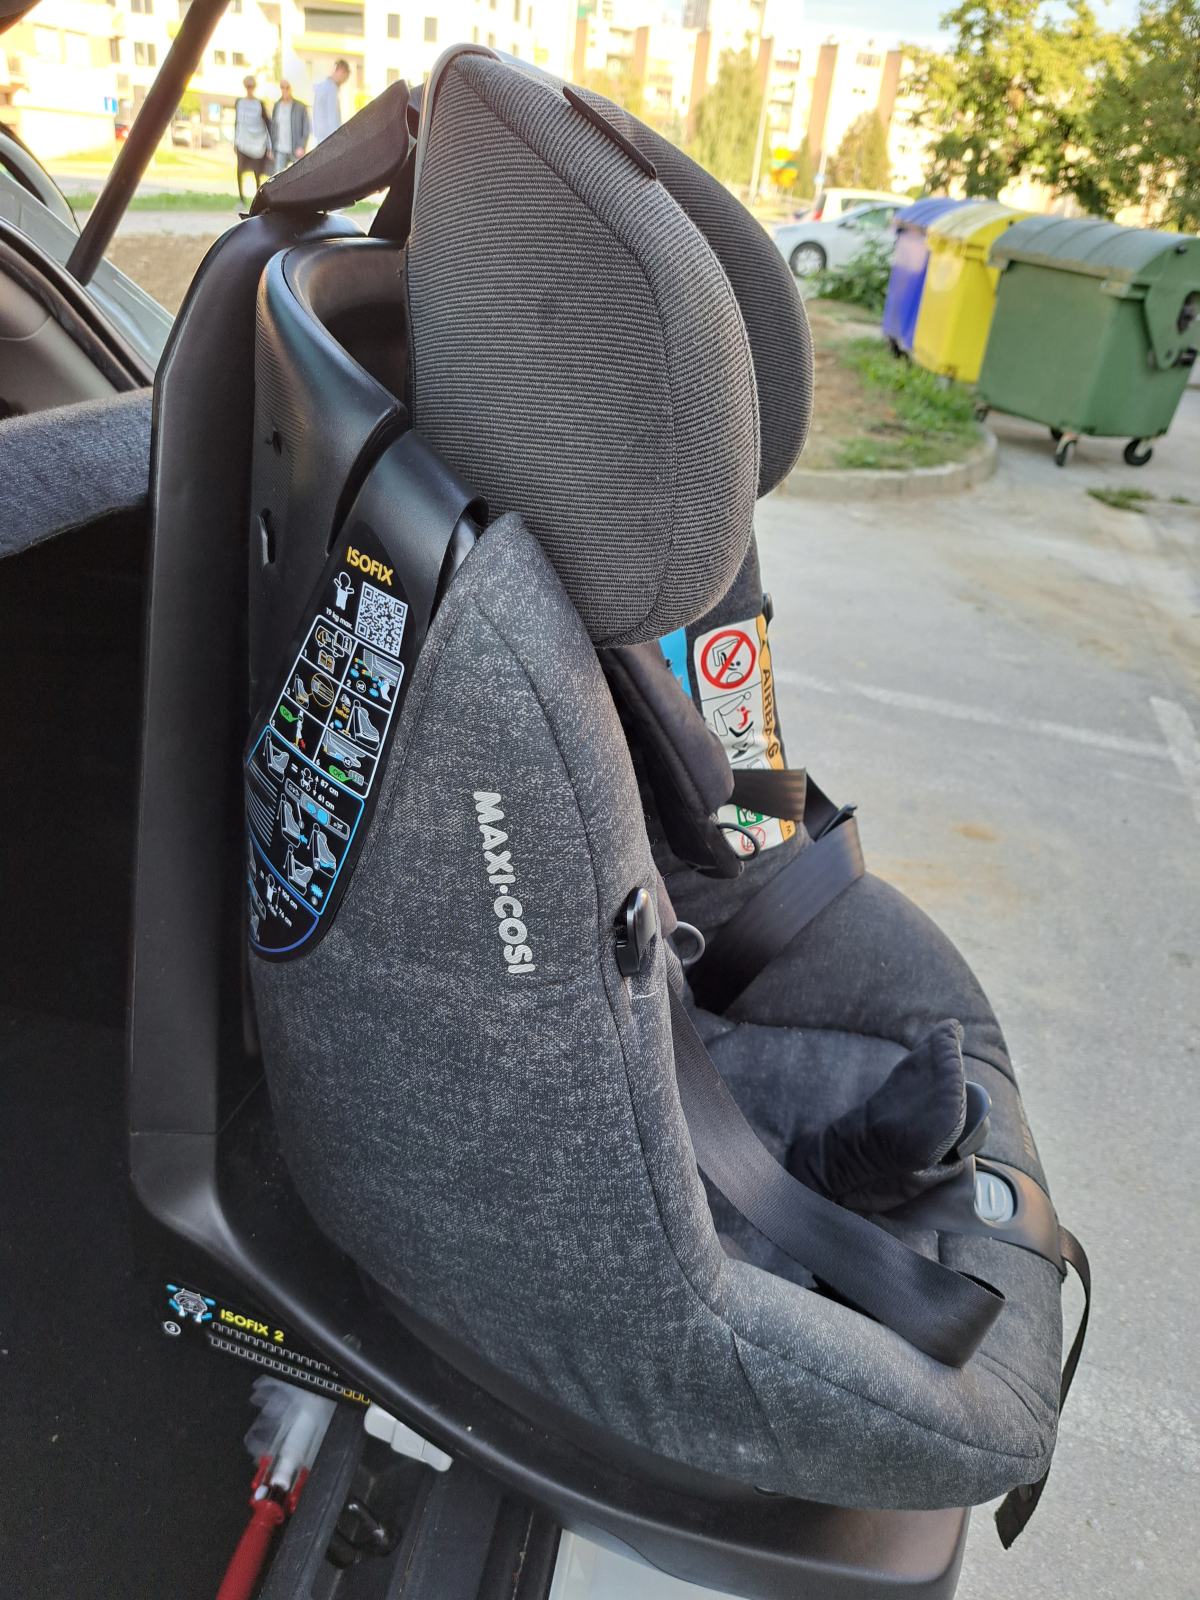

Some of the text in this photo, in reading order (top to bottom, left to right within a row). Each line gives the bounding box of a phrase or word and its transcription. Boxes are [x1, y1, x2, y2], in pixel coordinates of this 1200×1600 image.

[346, 546, 393, 586] ISOFIX
[219, 1308, 285, 1343] ISOFIX 2
